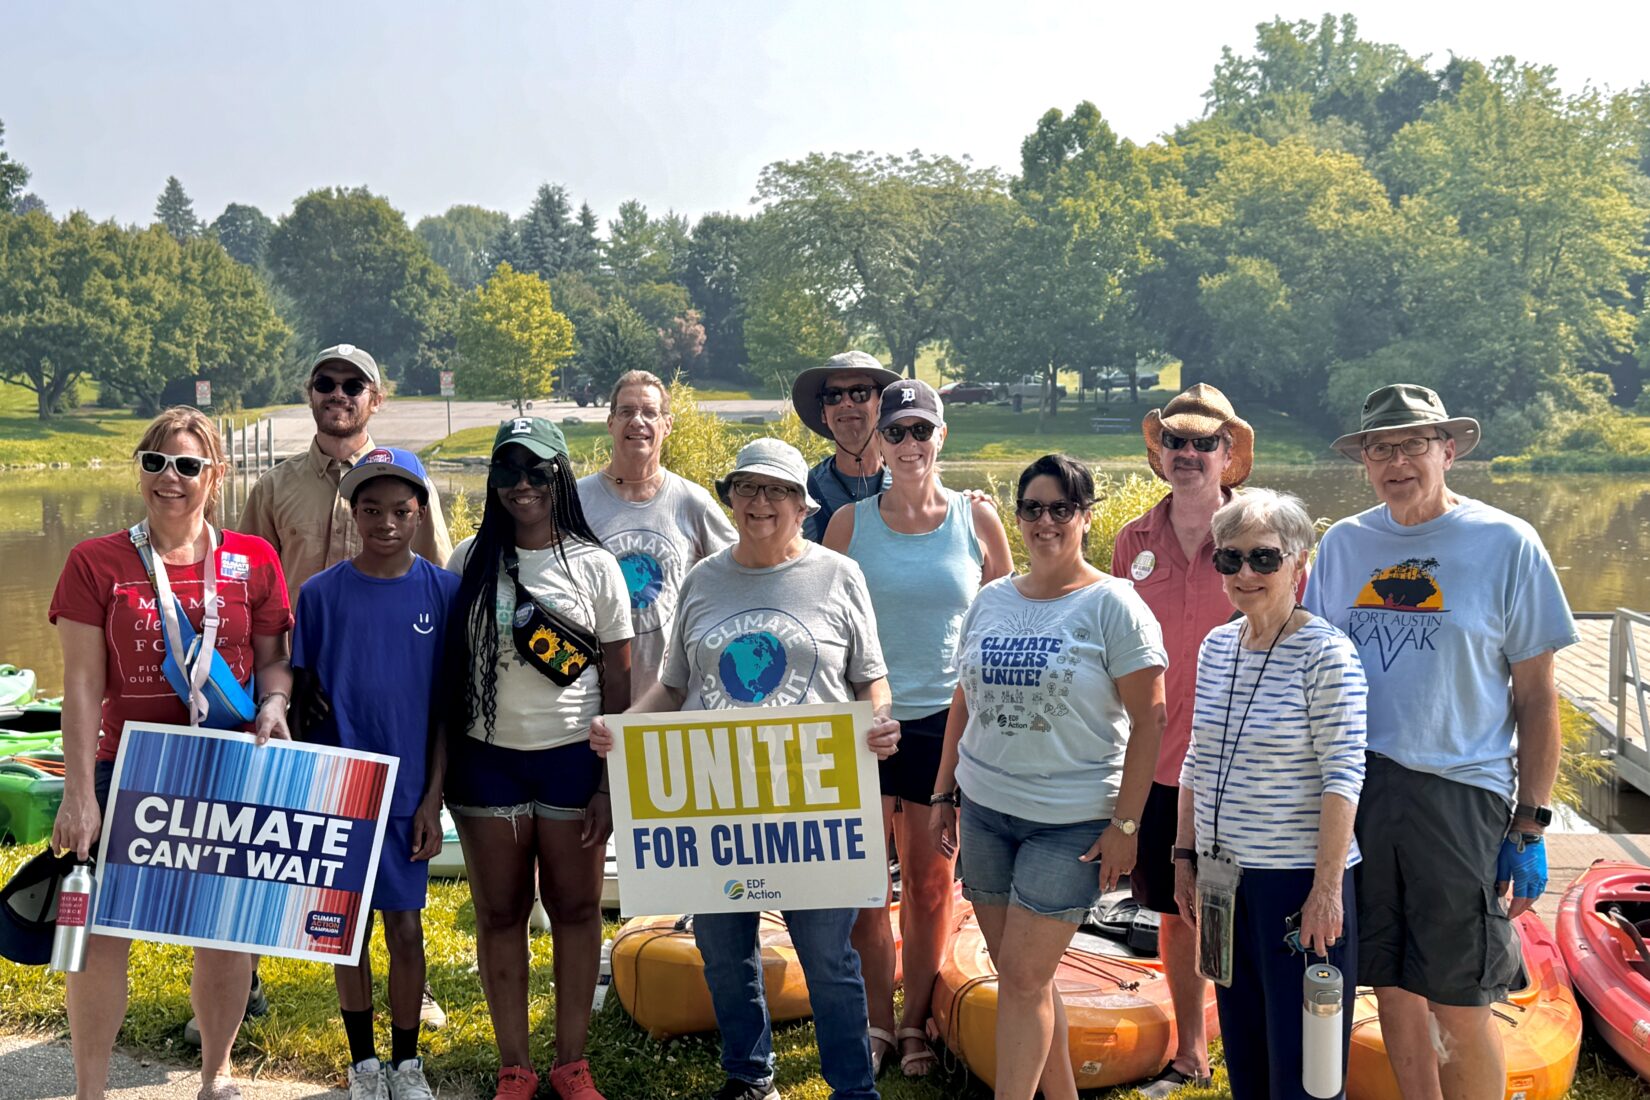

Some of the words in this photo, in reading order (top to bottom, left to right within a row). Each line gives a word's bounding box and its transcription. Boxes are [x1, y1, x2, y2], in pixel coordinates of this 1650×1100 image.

[901, 388, 916, 405] D
[511, 417, 533, 434] E
[1350, 610, 1388, 624] PORT
[1391, 614, 1442, 627] AUSTIN
[705, 613, 806, 649] CLIMATE
[981, 637, 1063, 653] CLIMATE
[1349, 622, 1439, 672] KAYAK
[981, 651, 1048, 670] VOTERS,
[981, 668, 1042, 687] UNITE!
[643, 722, 840, 813] UNITE
[134, 796, 353, 857] CLIMATE
[633, 826, 699, 869] FOR
[711, 818, 866, 866] CLIMATE
[128, 838, 236, 873] CAN'T
[246, 850, 344, 887] WAIT
[746, 879, 766, 889] EDF
[746, 890, 781, 900] Action
[311, 920, 340, 929] ACTION
[312, 914, 341, 923] CLIMATE
